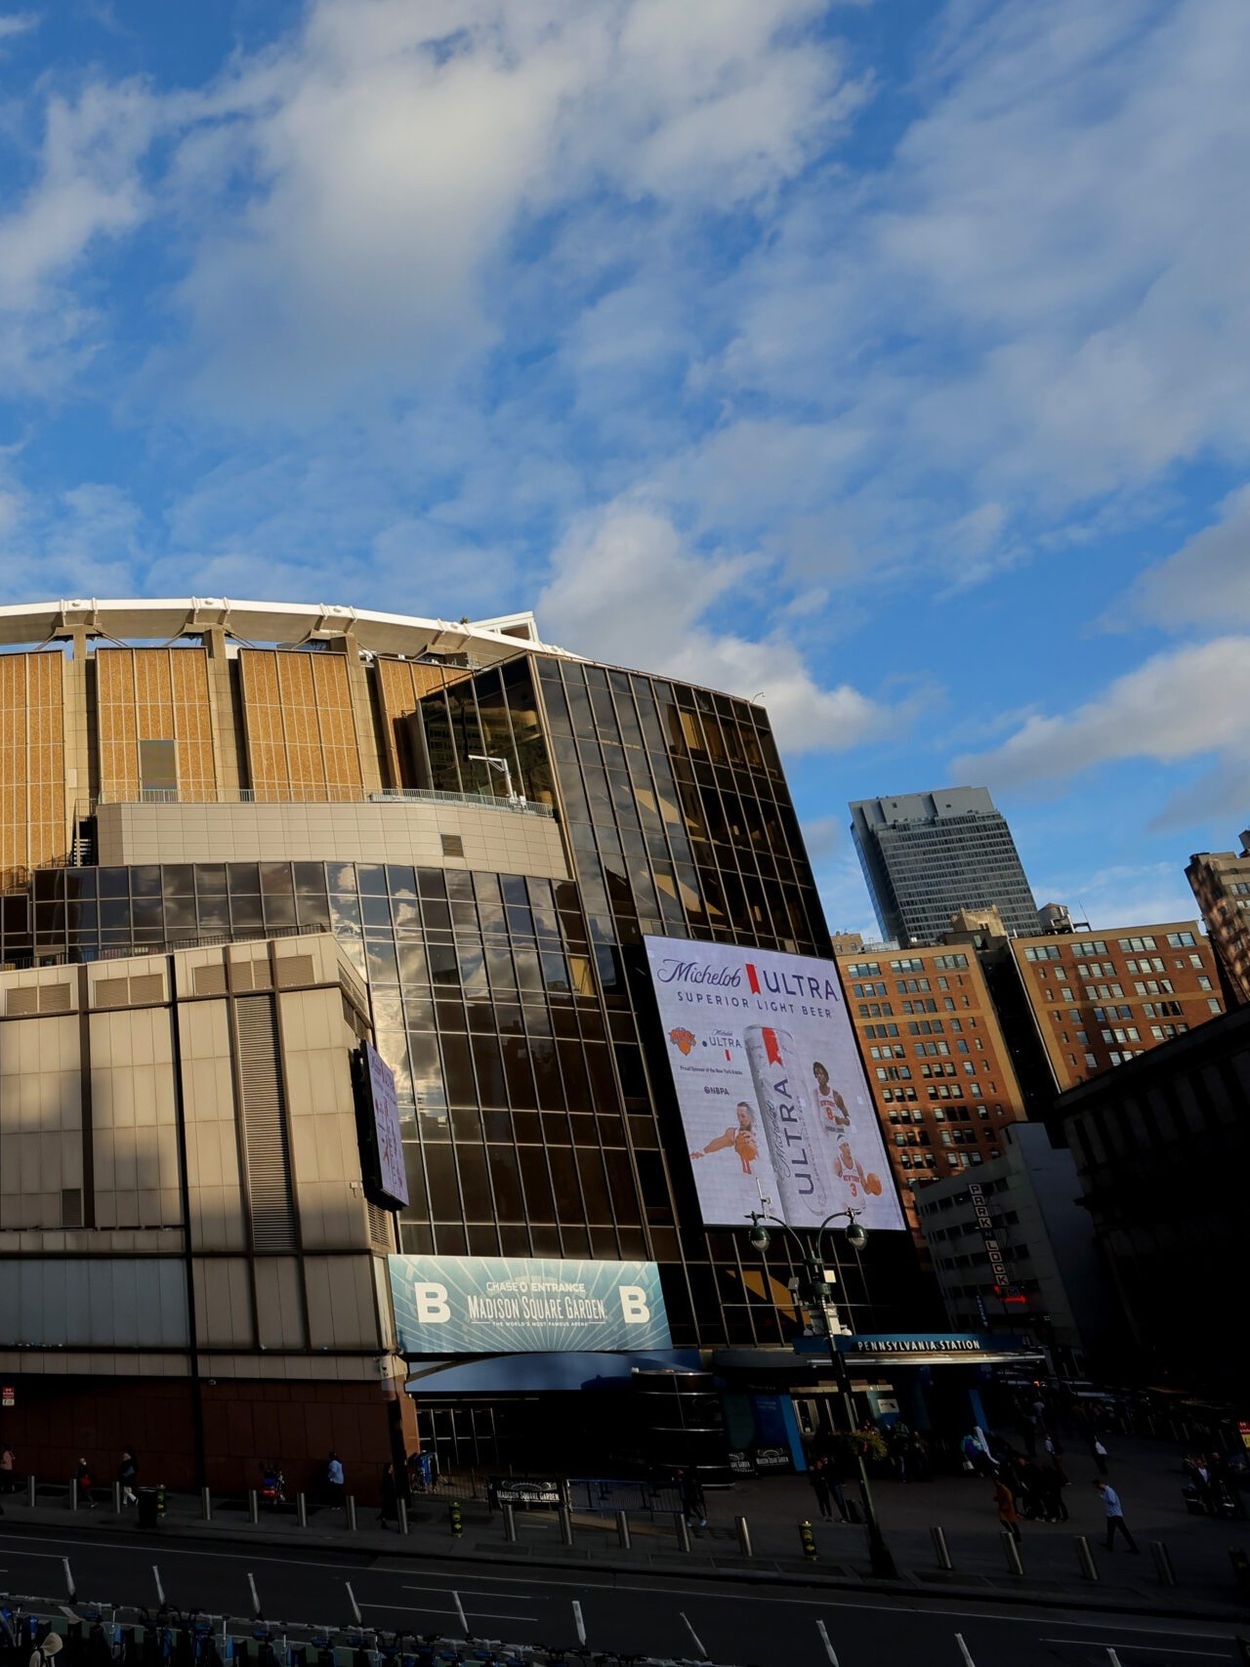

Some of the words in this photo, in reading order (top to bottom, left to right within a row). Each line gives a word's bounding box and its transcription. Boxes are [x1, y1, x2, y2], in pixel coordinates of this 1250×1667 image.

[657, 958, 741, 988] Michelob
[763, 970, 838, 1001] ULTRA
[677, 991, 749, 1008] SUPERIOR
[757, 1000, 794, 1014] LIGHT
[802, 1005, 832, 1018] BEER
[709, 1037, 742, 1048] ULTRA
[774, 1079, 814, 1194] ULTRA
[486, 1281, 518, 1292] CHASE
[531, 1282, 586, 1292] ENTRANCE
[414, 1282, 451, 1324] B
[467, 1295, 520, 1319] MADISON
[522, 1296, 564, 1320] SQUARE
[565, 1297, 606, 1319] GARDEN
[619, 1285, 651, 1324] B
[857, 1340, 937, 1351] PENNSYLVANIA
[940, 1340, 981, 1350] STATION
